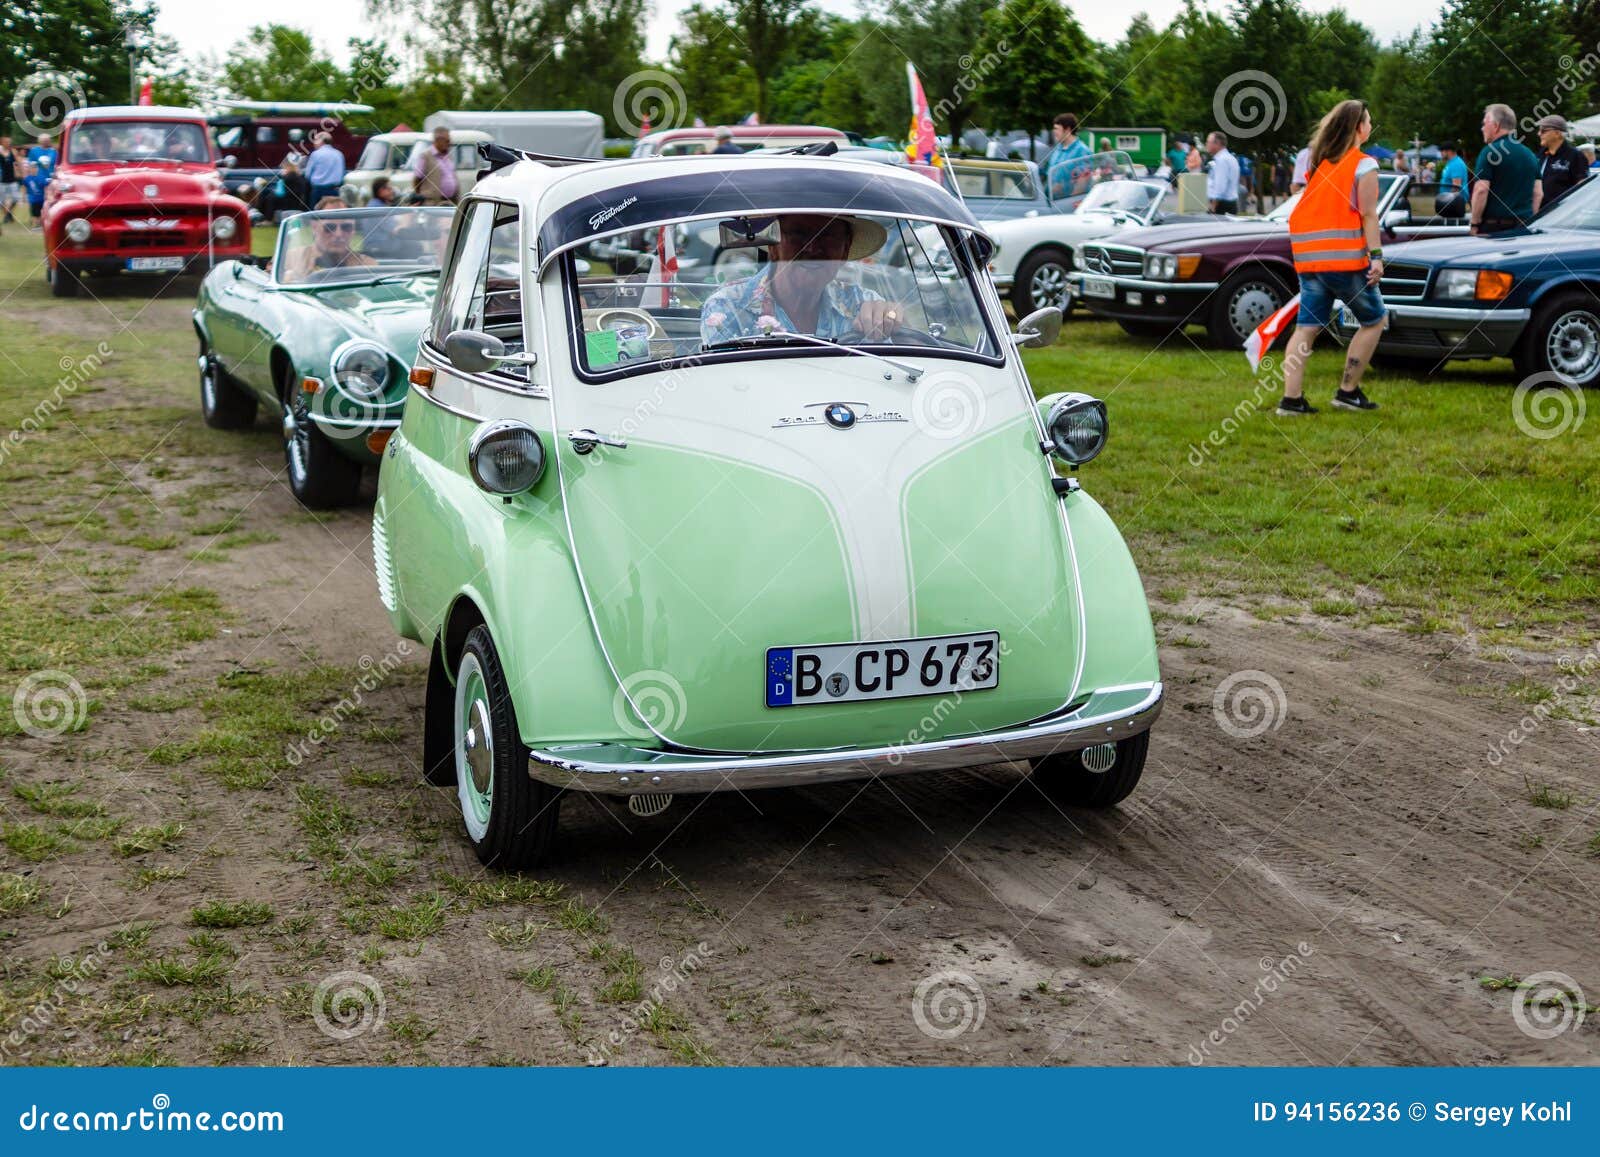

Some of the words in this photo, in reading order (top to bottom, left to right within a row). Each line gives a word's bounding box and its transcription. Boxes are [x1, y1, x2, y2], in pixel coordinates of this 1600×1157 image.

[796, 654, 823, 697] B
[855, 649, 909, 692] CP
[920, 640, 994, 687] 673
[775, 684, 784, 696] D
